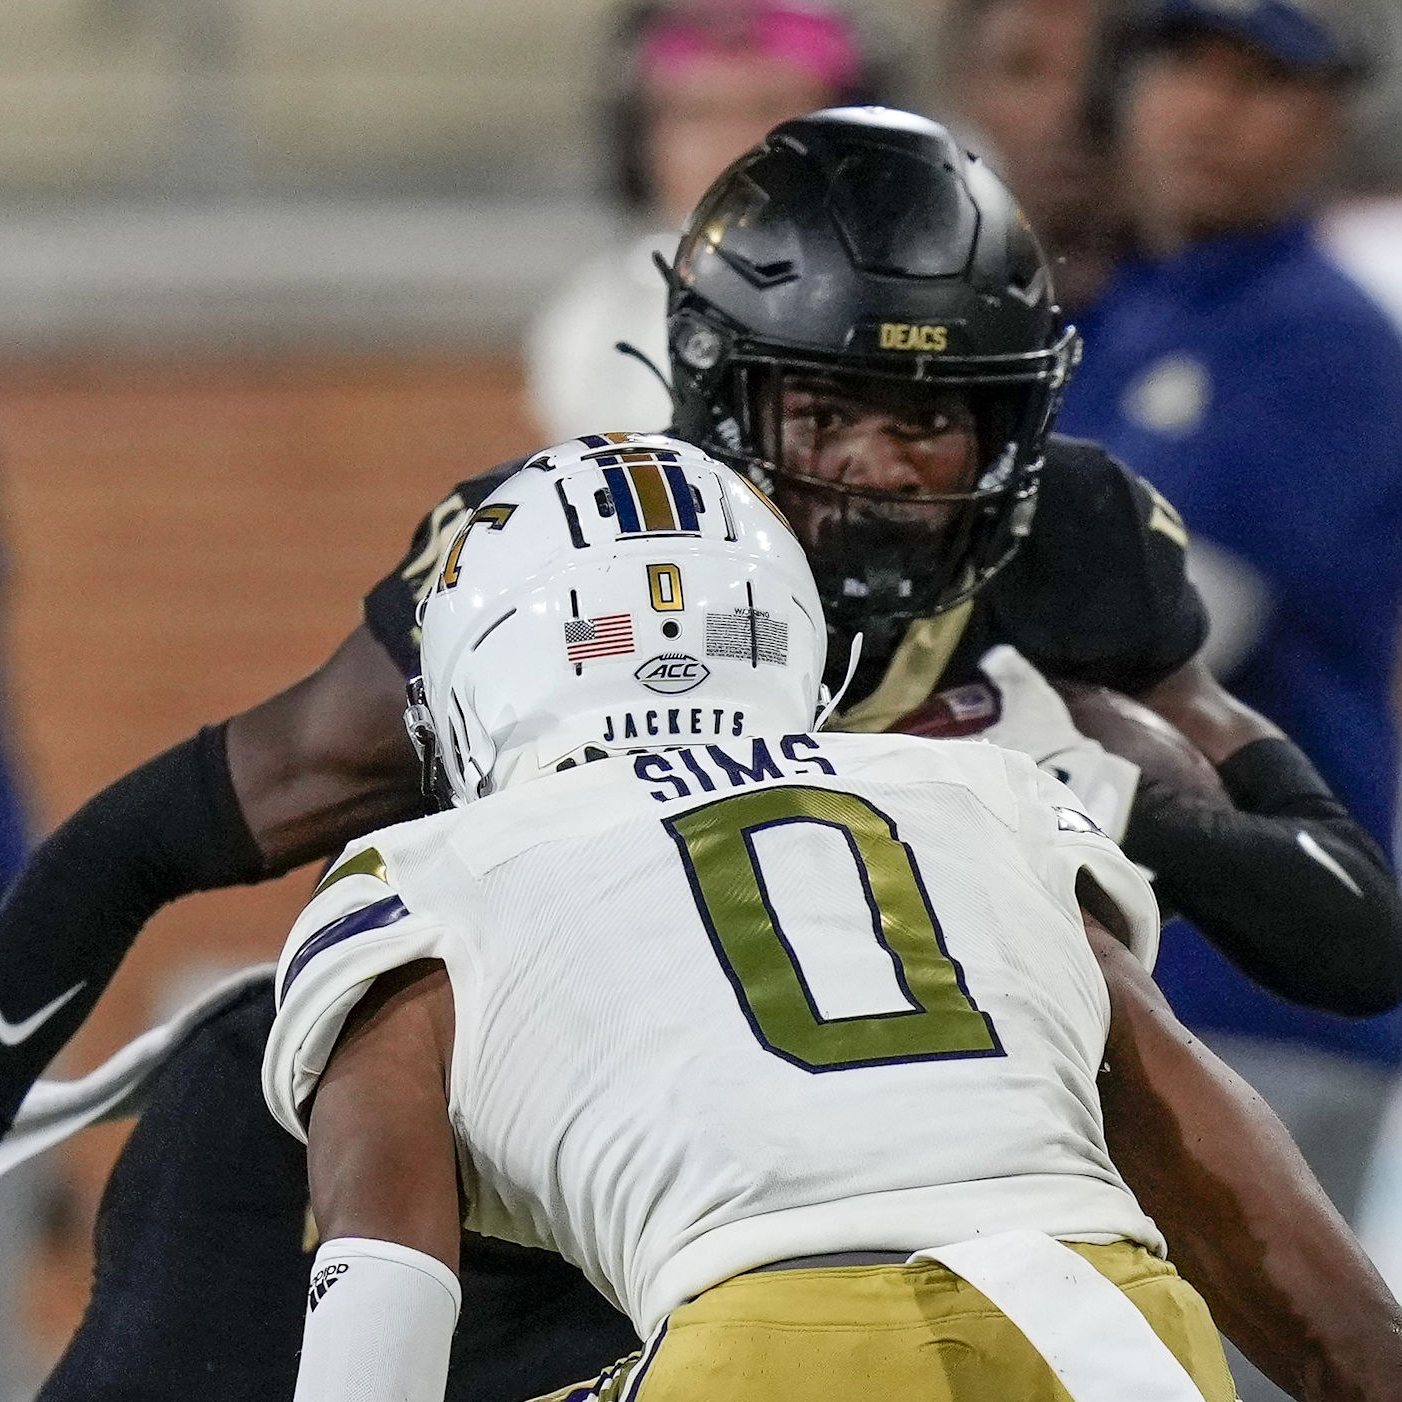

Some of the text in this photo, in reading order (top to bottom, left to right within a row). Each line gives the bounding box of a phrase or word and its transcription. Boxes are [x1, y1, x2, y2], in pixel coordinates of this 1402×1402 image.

[879, 323, 948, 350] DEACS
[646, 563, 685, 612] 0
[734, 608, 770, 619] WNING
[646, 663, 700, 679] ACC
[603, 708, 745, 741] JACKETS
[633, 733, 837, 802] SIMS
[661, 785, 1007, 1075] 0
[311, 1263, 349, 1288] adid
